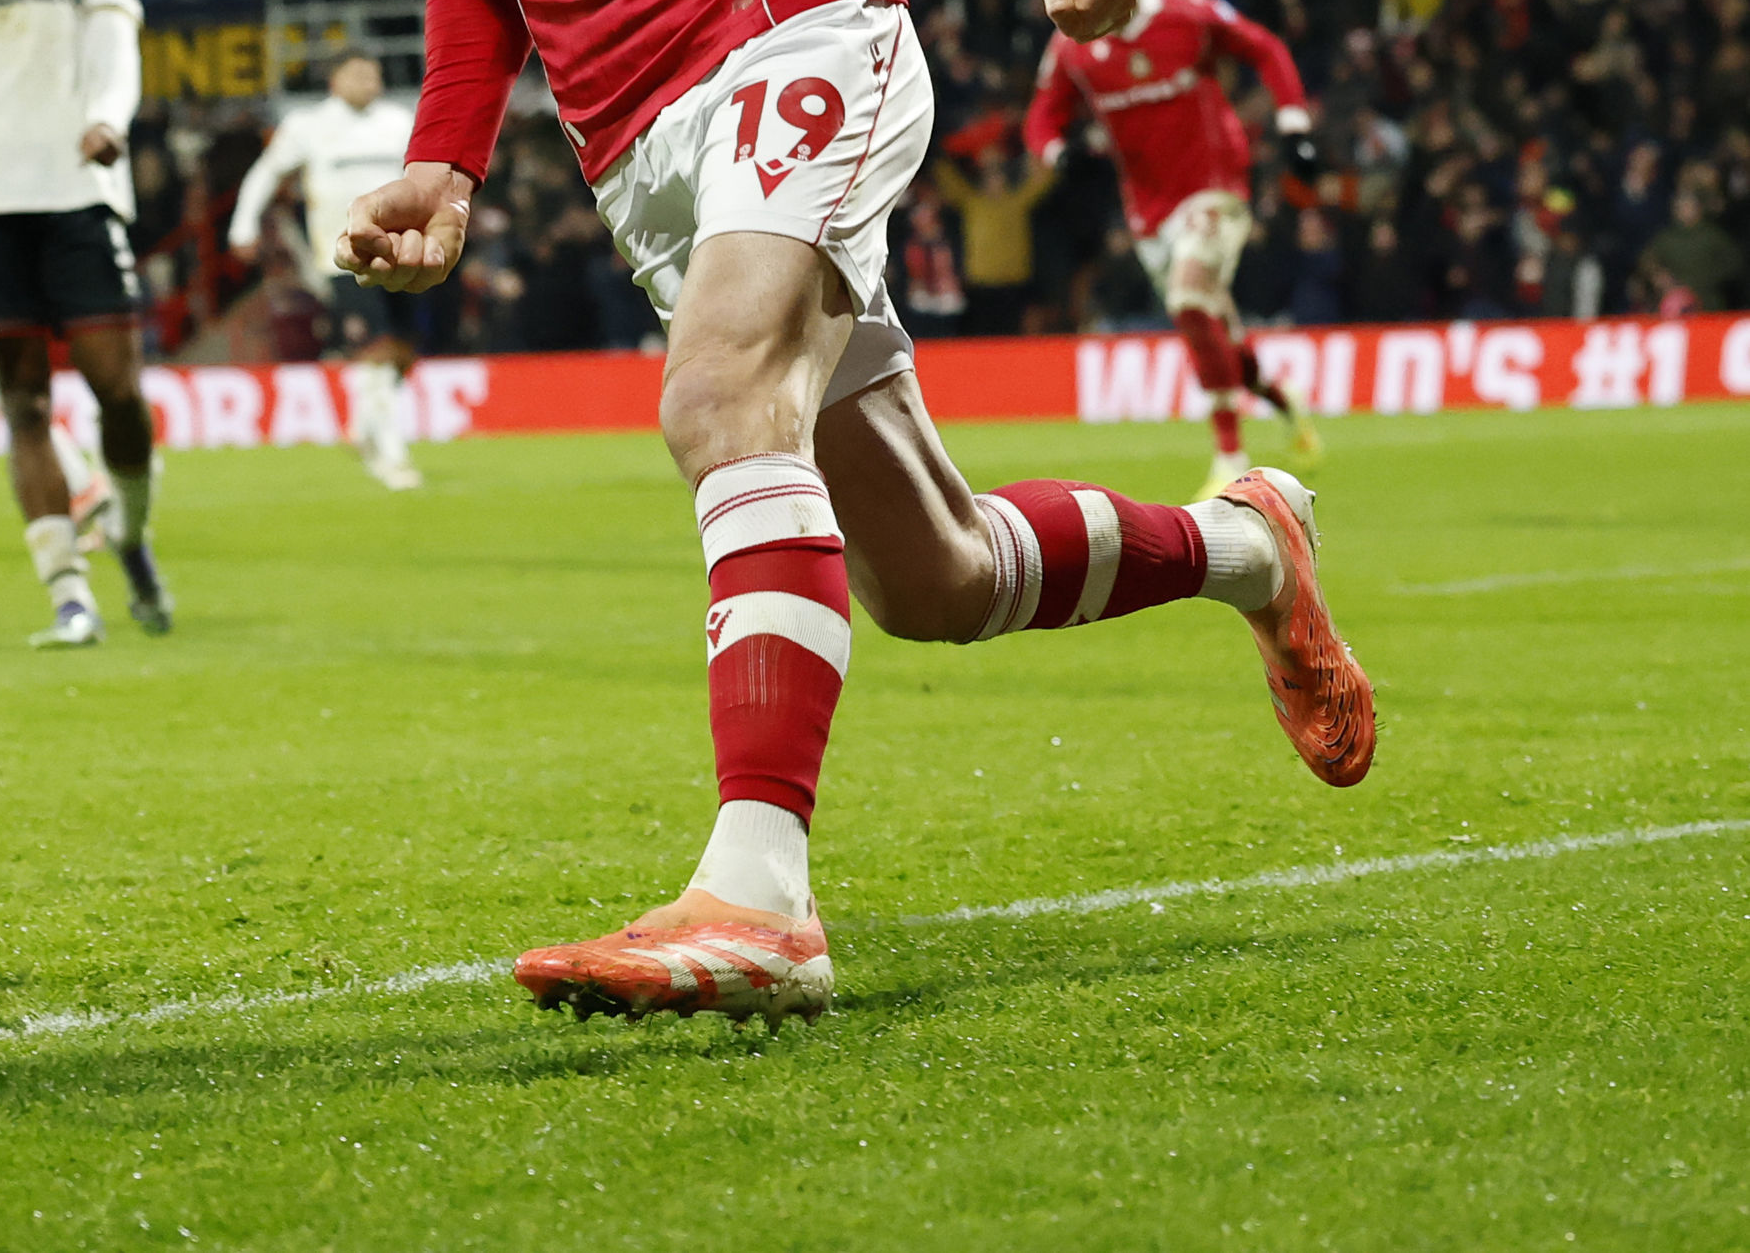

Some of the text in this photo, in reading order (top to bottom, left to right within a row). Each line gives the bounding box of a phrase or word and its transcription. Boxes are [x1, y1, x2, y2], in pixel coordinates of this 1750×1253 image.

[730, 76, 846, 164] 19
[1077, 320, 1544, 423] WRLD'S
[1568, 322, 1689, 410] #1
